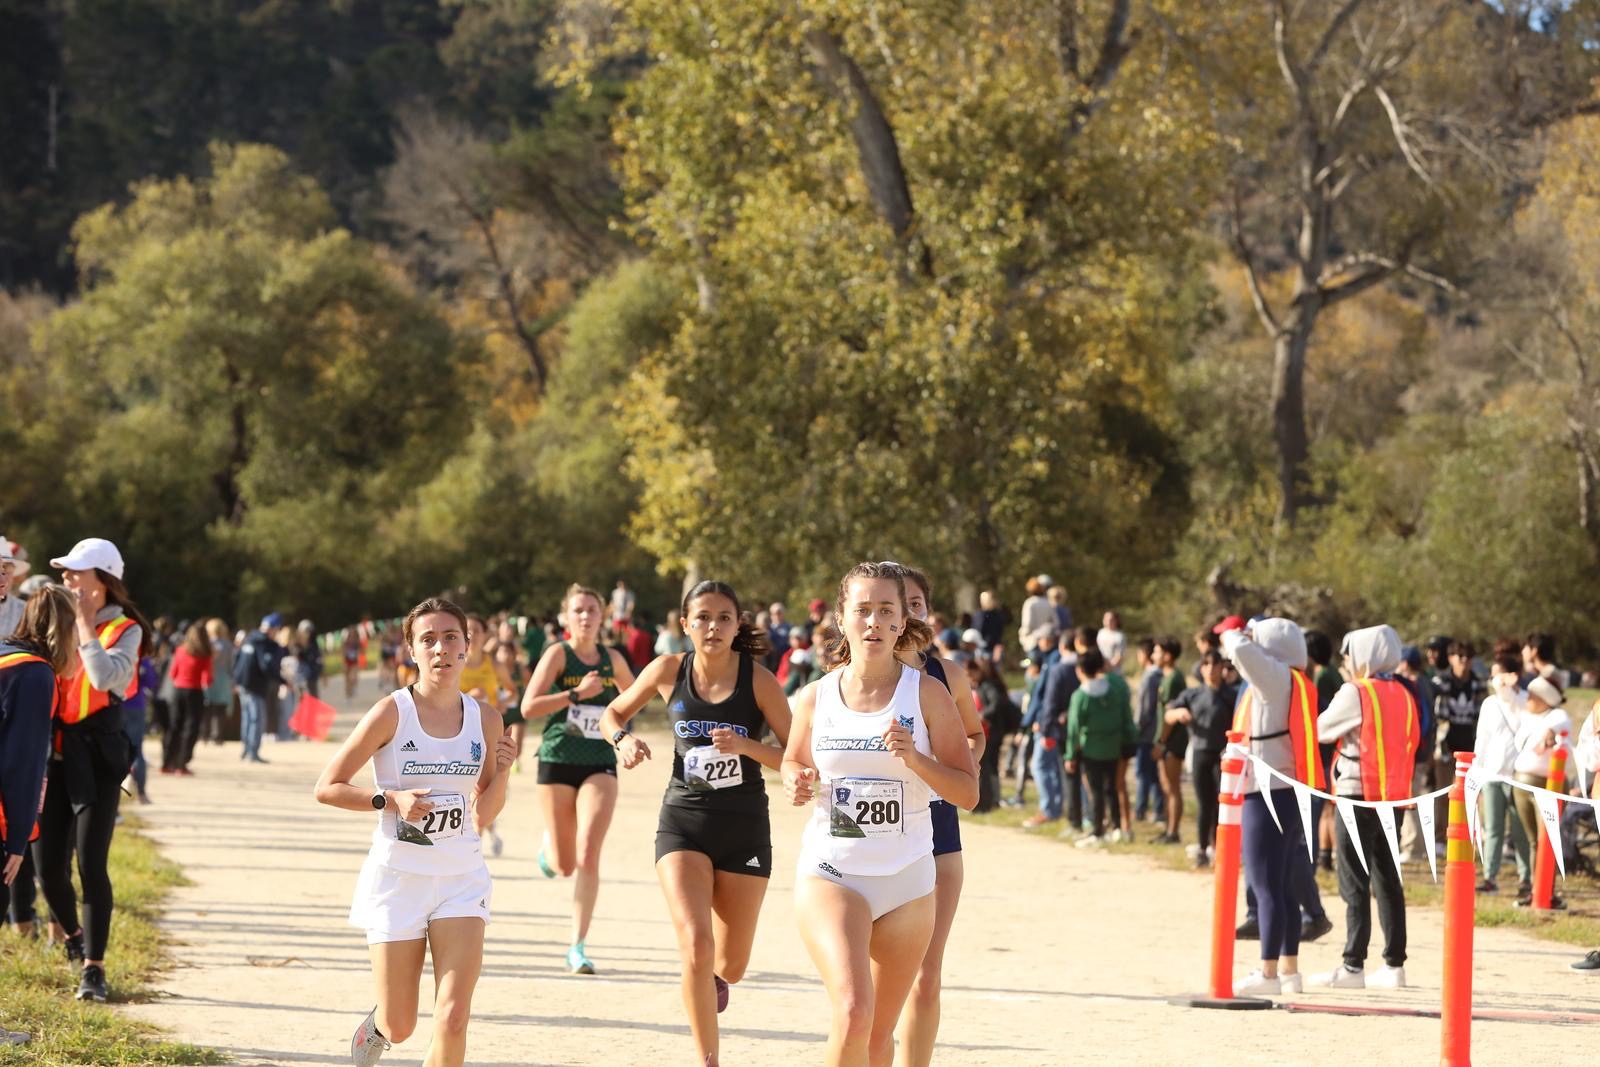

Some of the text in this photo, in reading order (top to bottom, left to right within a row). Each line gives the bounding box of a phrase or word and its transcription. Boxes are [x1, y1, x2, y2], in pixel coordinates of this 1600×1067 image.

[584, 717, 601, 731] 12
[402, 761, 480, 775] SONOMA STATE
[704, 758, 740, 782] 222
[422, 807, 463, 834] 278
[855, 800, 900, 825] 280
[818, 863, 842, 878] adidas
